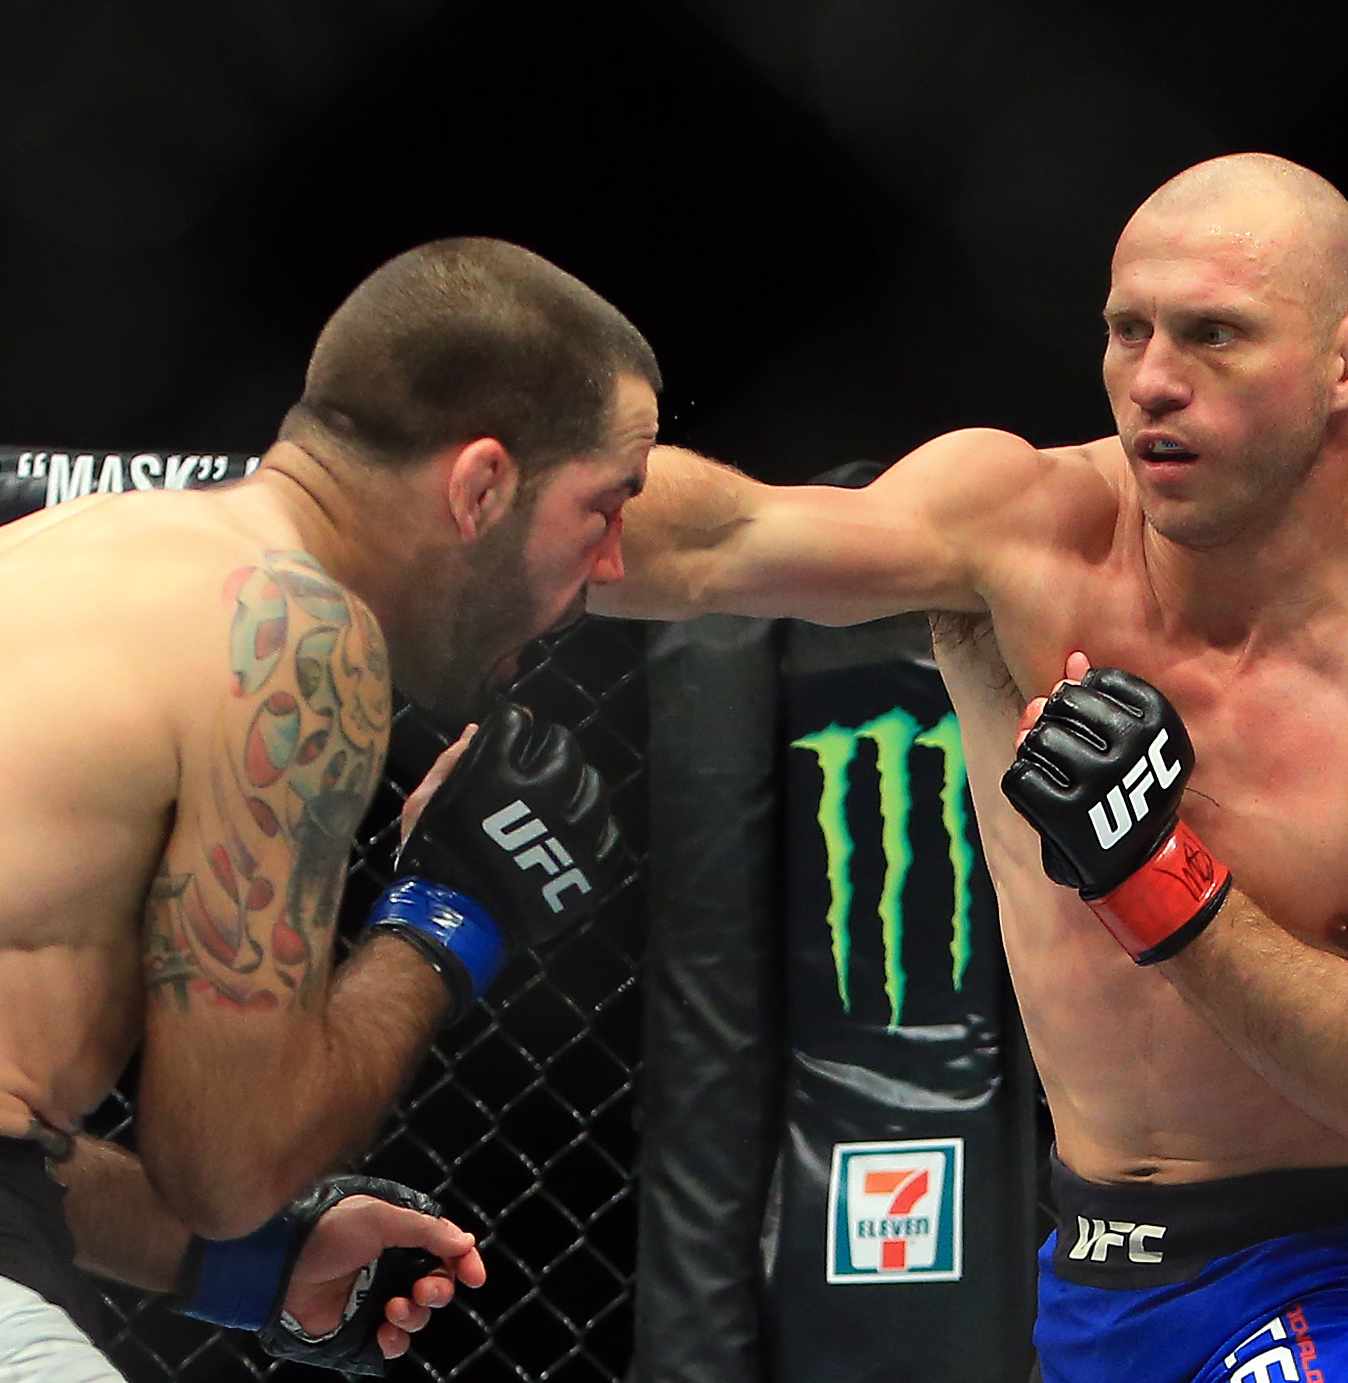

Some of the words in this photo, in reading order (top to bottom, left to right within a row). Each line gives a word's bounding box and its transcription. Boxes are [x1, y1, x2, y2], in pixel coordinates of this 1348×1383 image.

[1088, 728, 1182, 850] UFC
[481, 799, 592, 914] UFC
[865, 1169, 930, 1269] 7
[1068, 1214, 1167, 1265] UFC
